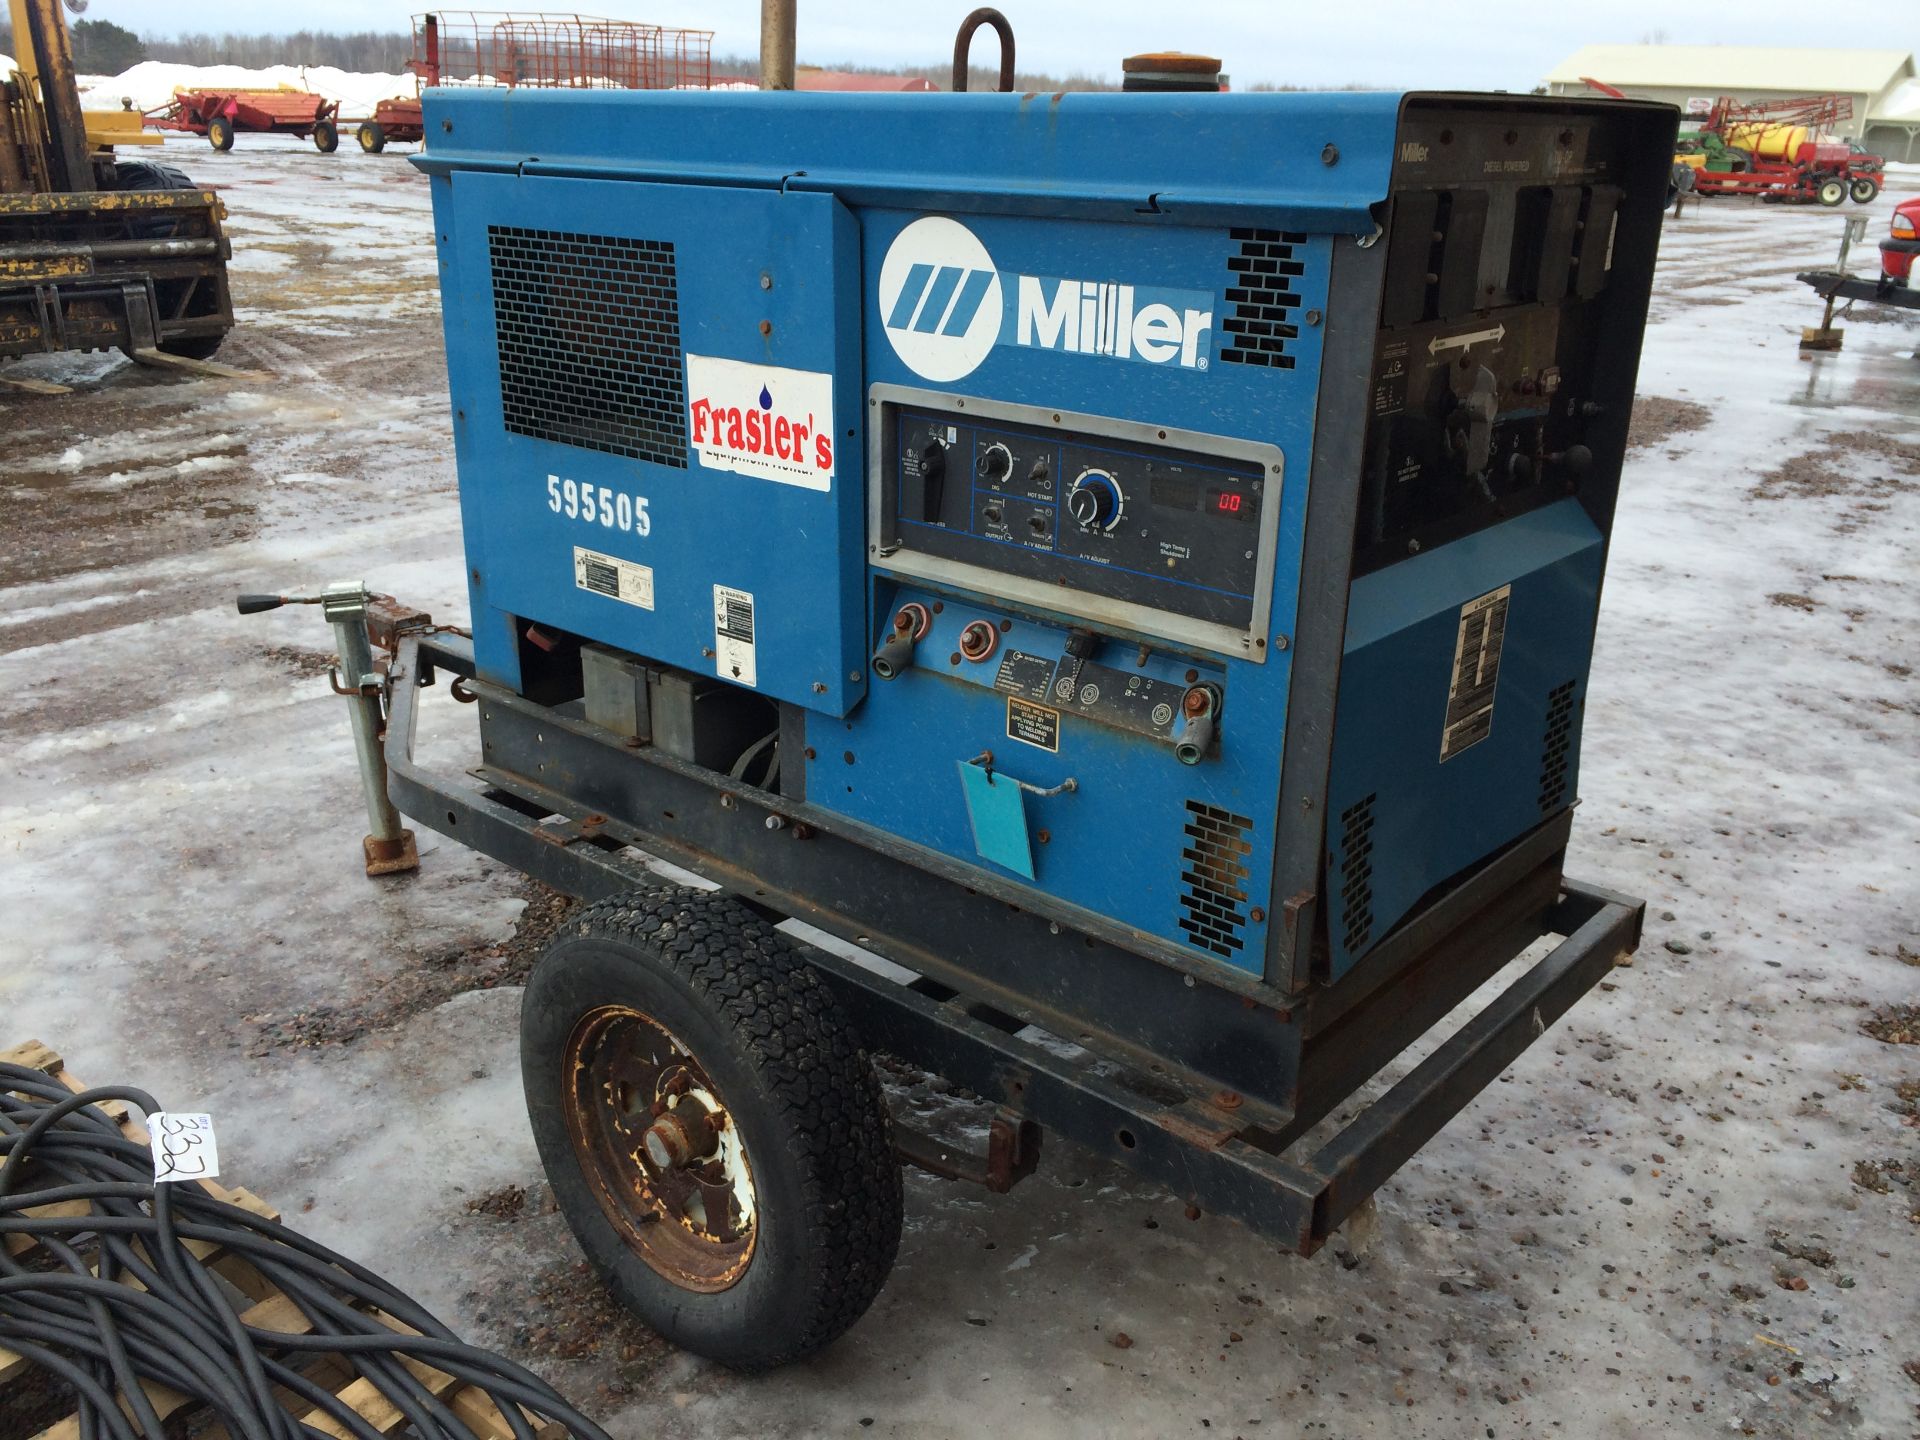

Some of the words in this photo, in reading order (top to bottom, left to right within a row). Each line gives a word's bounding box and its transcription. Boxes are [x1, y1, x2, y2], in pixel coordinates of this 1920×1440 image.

[1401, 142, 1430, 163] Miller
[1503, 159, 1530, 173] POWERED
[1017, 275, 1212, 368] Miller
[690, 398, 833, 470] Frasier's
[1027, 491, 1037, 499] HOT
[1037, 493, 1053, 502] START
[546, 474, 652, 538] 595505
[984, 531, 1003, 541] OUTPUT
[1102, 531, 1115, 539] MAX
[1034, 543, 1053, 552] ADJUST
[1159, 541, 1172, 550] High
[1172, 544, 1186, 553] Temp
[1090, 555, 1111, 564] ADJUST
[725, 591, 748, 602] WARNING
[1011, 701, 1031, 713] WELDER
[1032, 707, 1045, 717] WILL
[1044, 712, 1056, 721] NOT
[1021, 711, 1037, 721] START
[1037, 716, 1045, 724] BY
[1011, 714, 1035, 727] APPLYING
[1035, 722, 1055, 734] POWER
[1017, 722, 1025, 730] TO
[1025, 725, 1047, 738] WELDING
[1018, 729, 1046, 743] TERMINALS
[157, 1116, 205, 1178] 332
